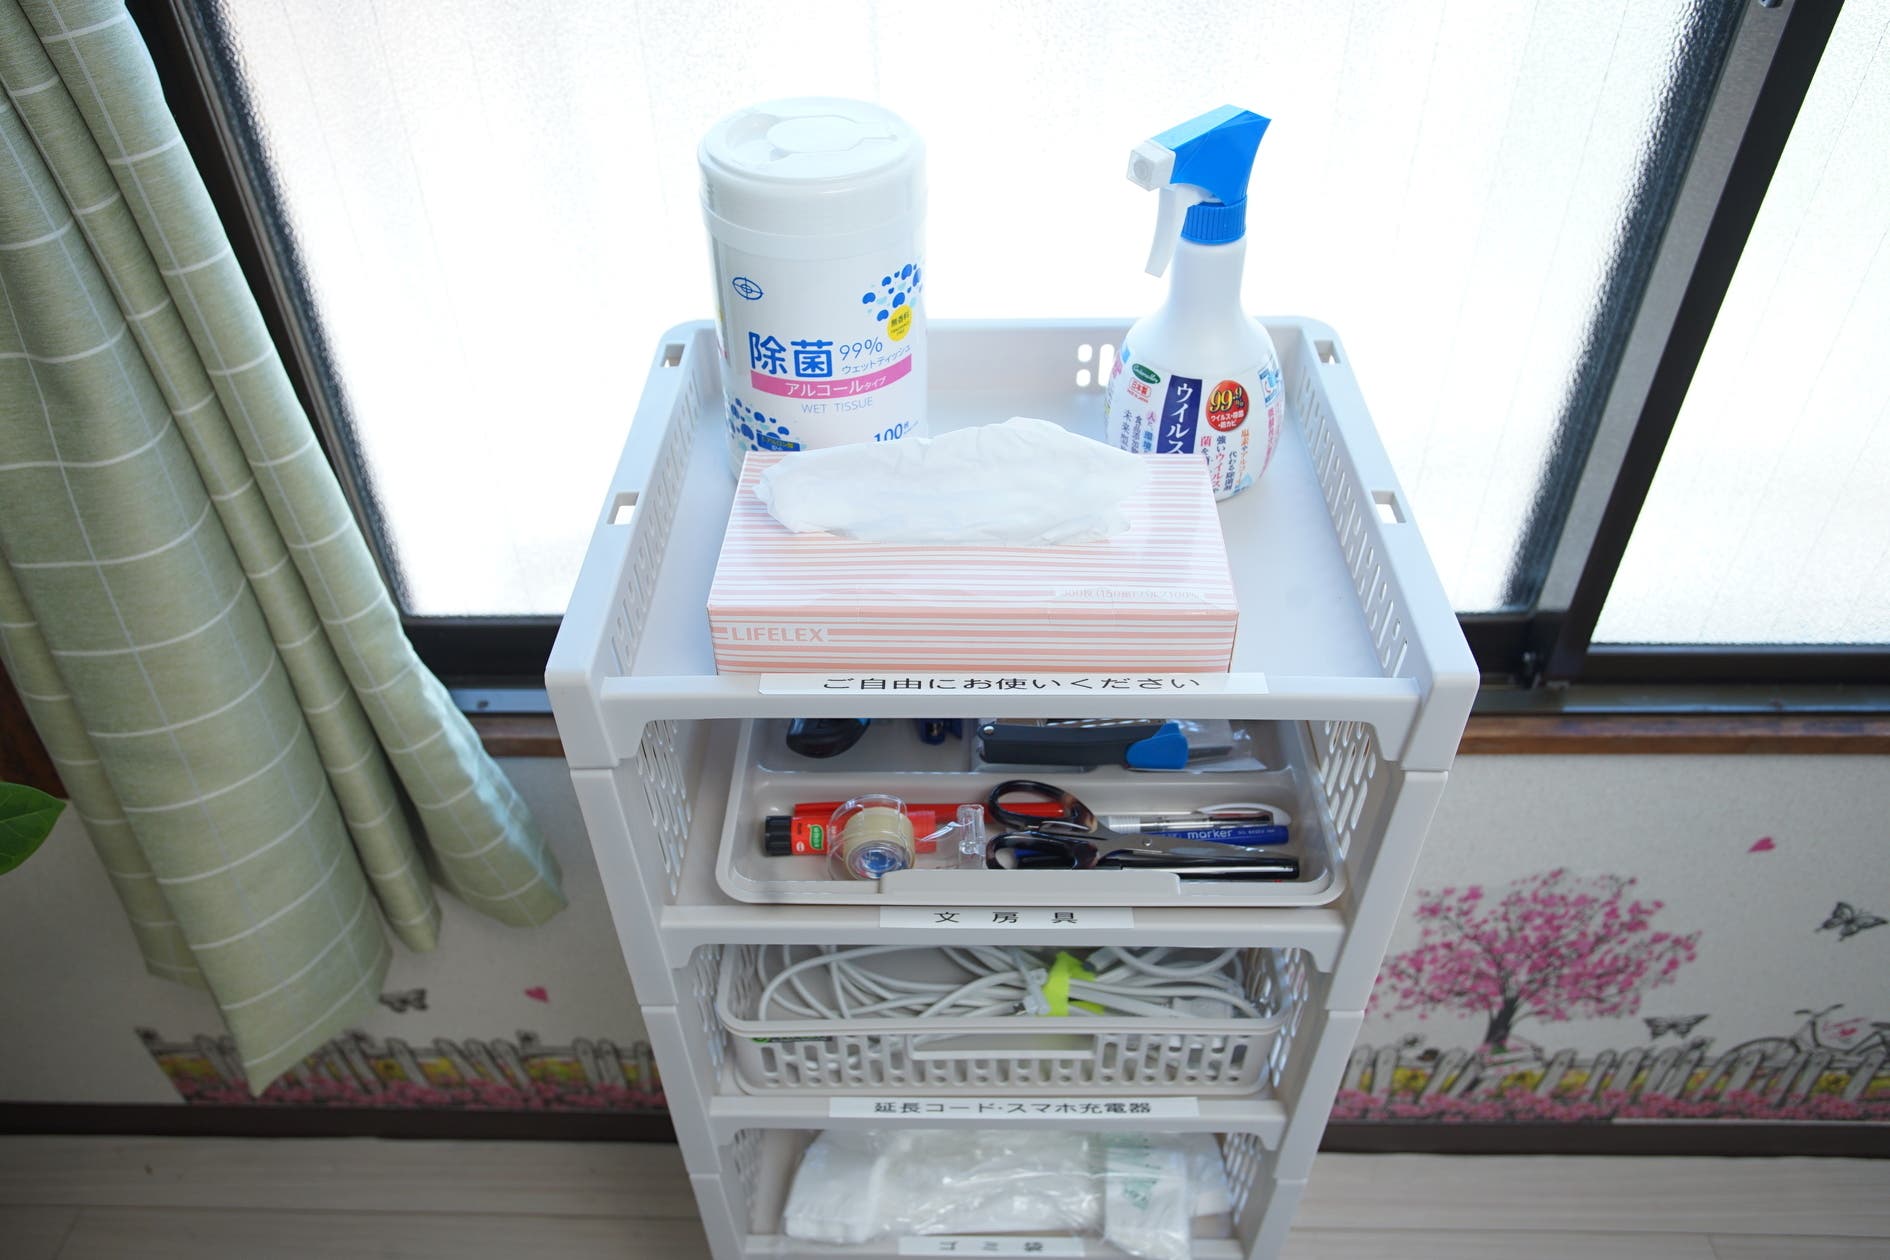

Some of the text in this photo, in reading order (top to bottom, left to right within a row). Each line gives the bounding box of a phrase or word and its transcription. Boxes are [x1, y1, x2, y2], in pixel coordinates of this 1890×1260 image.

[748, 331, 834, 378] 除菌
[839, 336, 884, 361] 99%
[801, 396, 874, 414] WET TISSUE
[731, 627, 824, 643] LIFELEX
[823, 676, 1201, 691] ご自由にお使いください
[1187, 828, 1233, 840] marker
[873, 1101, 1152, 1114] 延長コード・スマホ充電器
